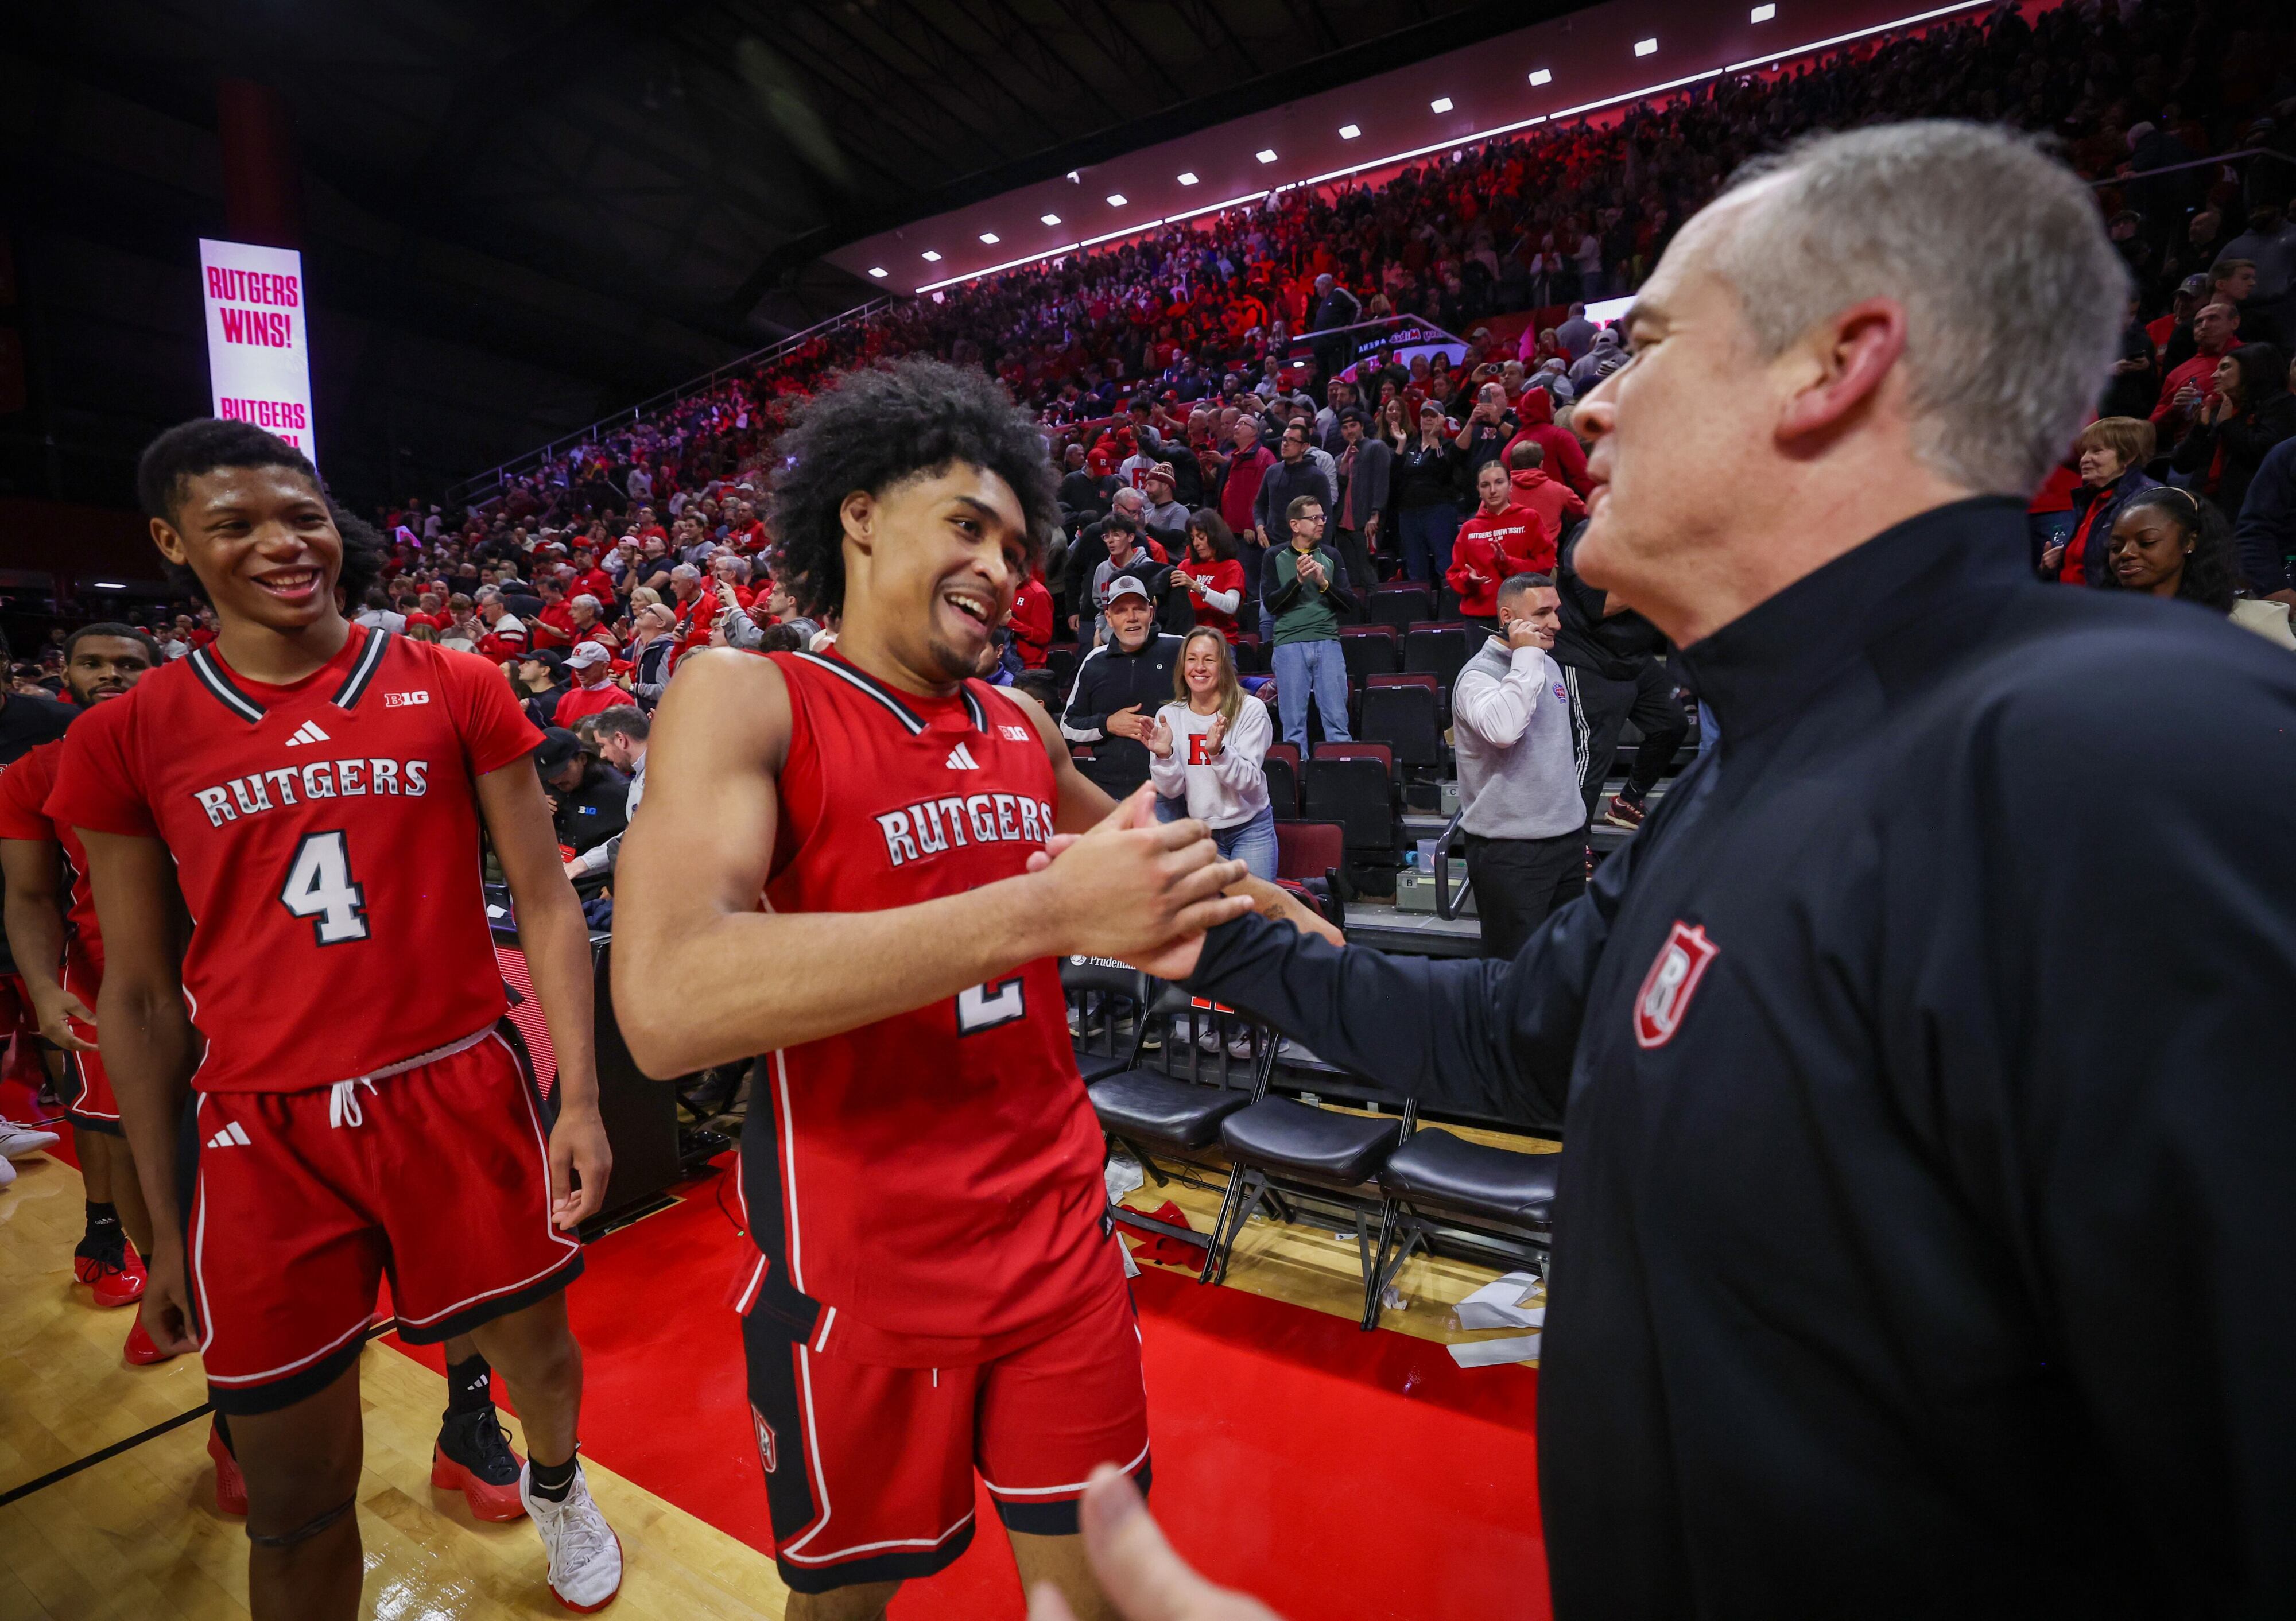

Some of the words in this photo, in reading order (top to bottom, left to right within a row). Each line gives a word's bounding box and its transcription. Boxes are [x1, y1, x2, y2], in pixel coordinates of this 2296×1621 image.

[207, 266, 298, 308] RUTGERS
[220, 307, 292, 348] WINS!
[1468, 530, 1492, 540] RUTGERS
[1017, 596, 1025, 606] R
[573, 648, 582, 657] R
[193, 758, 429, 828] RUTGERS
[876, 794, 1054, 867] RUTGERS
[278, 829, 371, 947] 4
